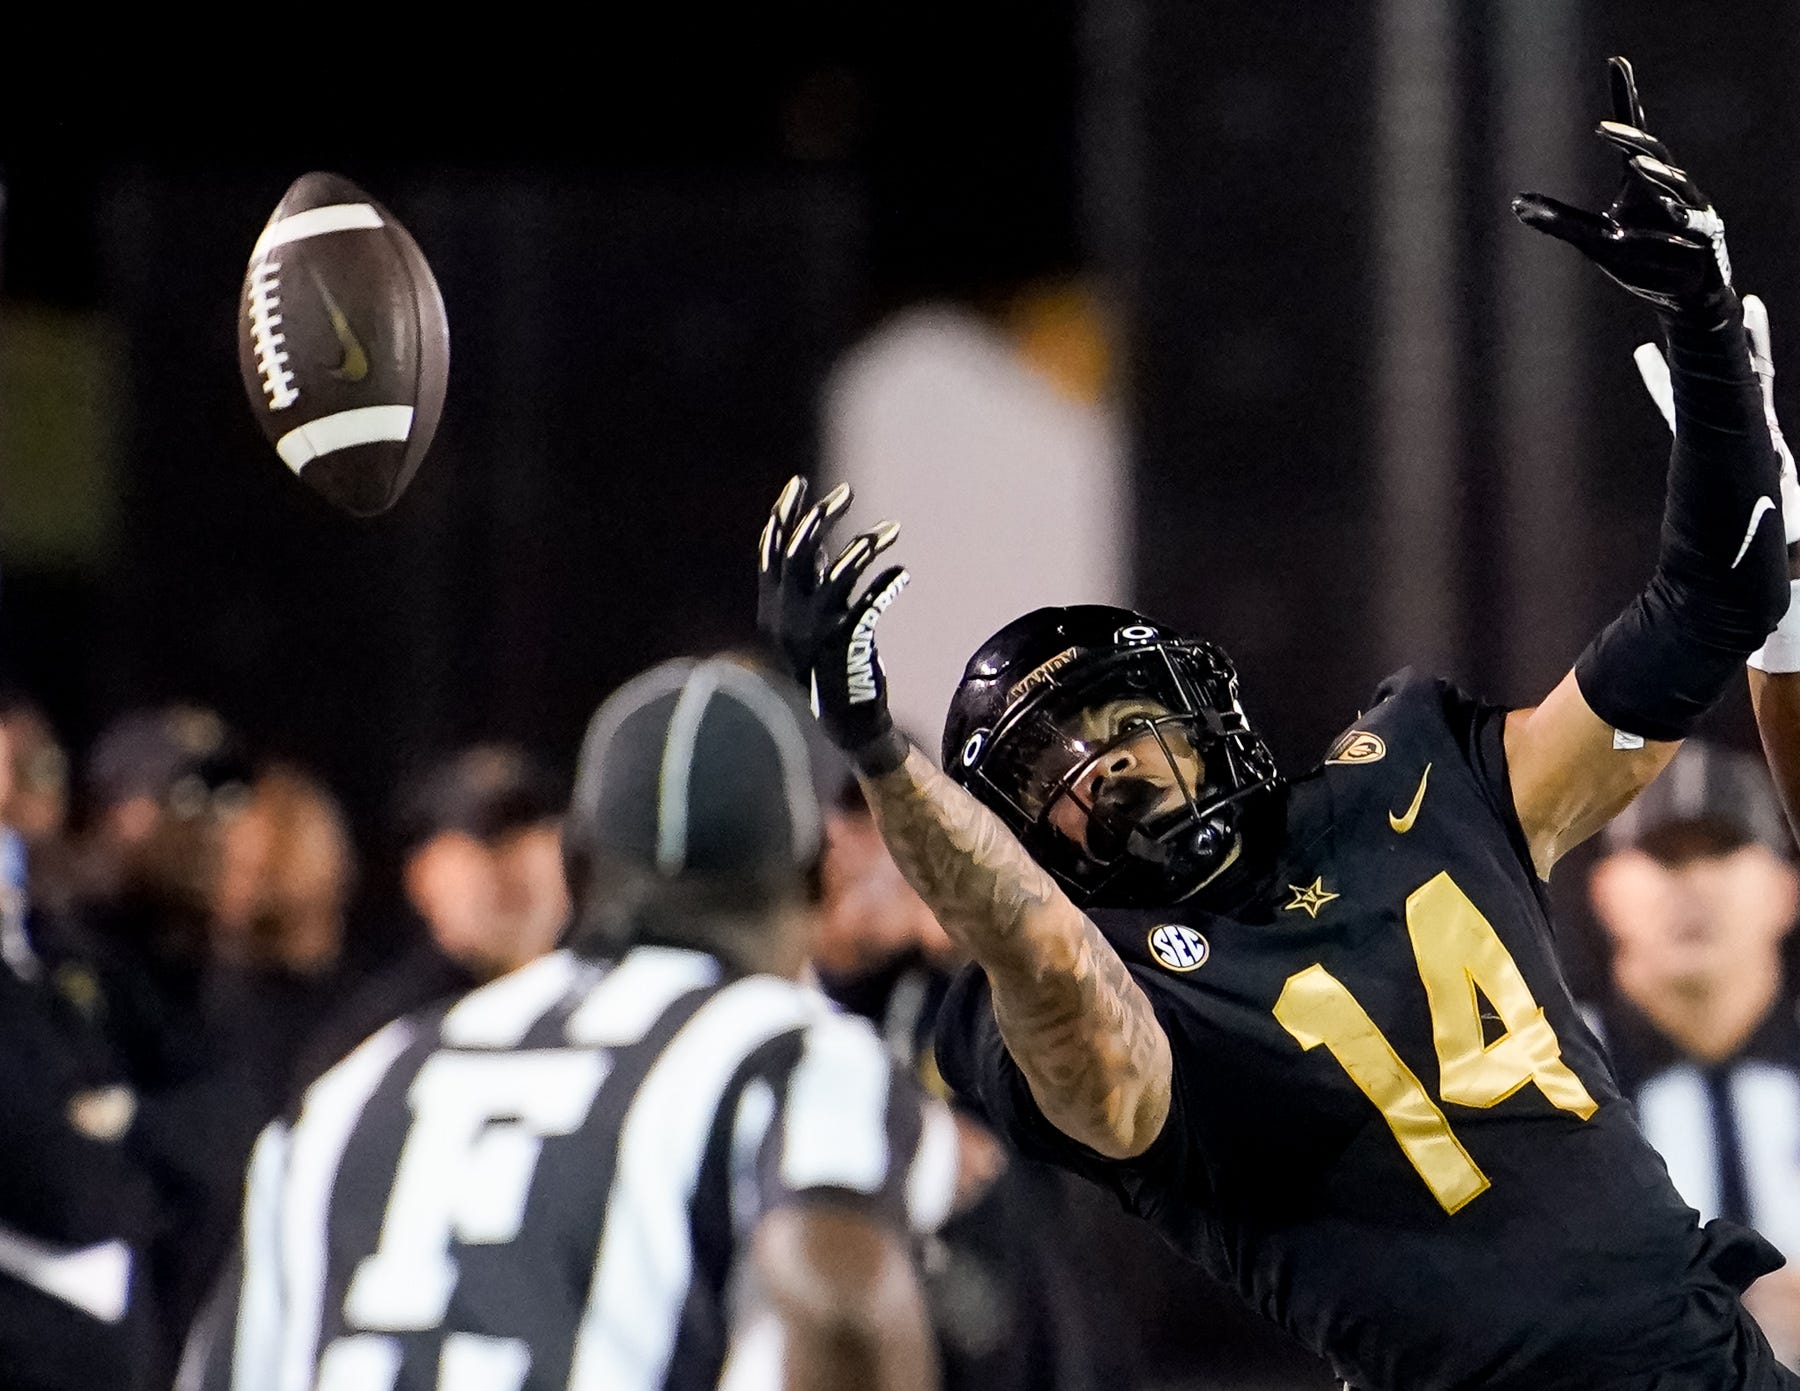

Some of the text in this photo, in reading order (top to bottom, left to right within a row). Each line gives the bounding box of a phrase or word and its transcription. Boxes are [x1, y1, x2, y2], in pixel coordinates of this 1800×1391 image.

[1009, 646, 1078, 698] VANDY
[1152, 925, 1205, 968] SEC
[1272, 871, 1598, 1216] 14
[344, 1049, 614, 1332] F
